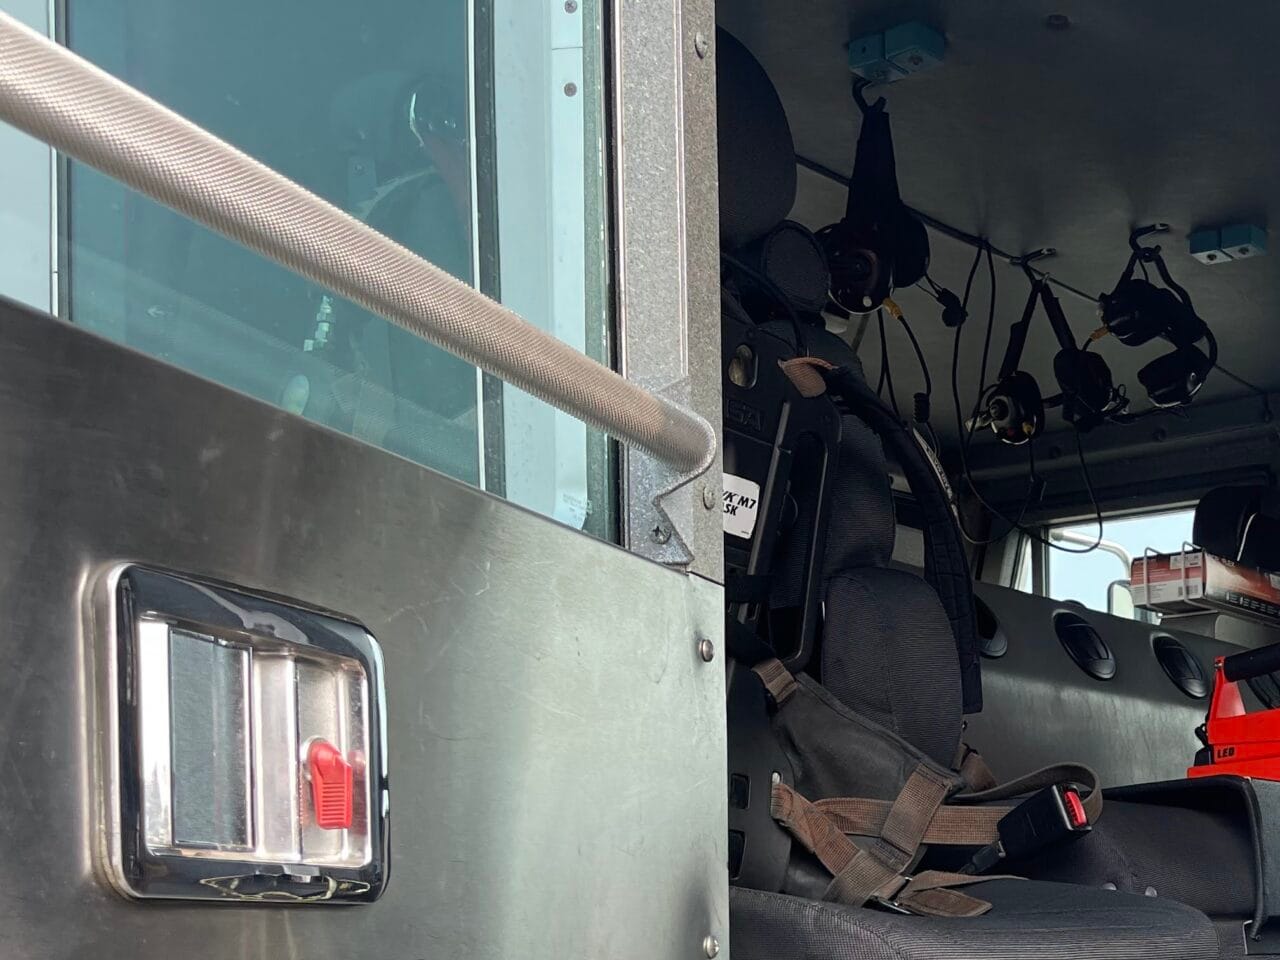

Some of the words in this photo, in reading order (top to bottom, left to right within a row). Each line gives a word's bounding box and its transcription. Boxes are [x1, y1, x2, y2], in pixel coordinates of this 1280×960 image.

[723, 491, 739, 503] K
[737, 495, 757, 510] M7
[723, 503, 739, 516] SK
[1217, 747, 1235, 759] LED
